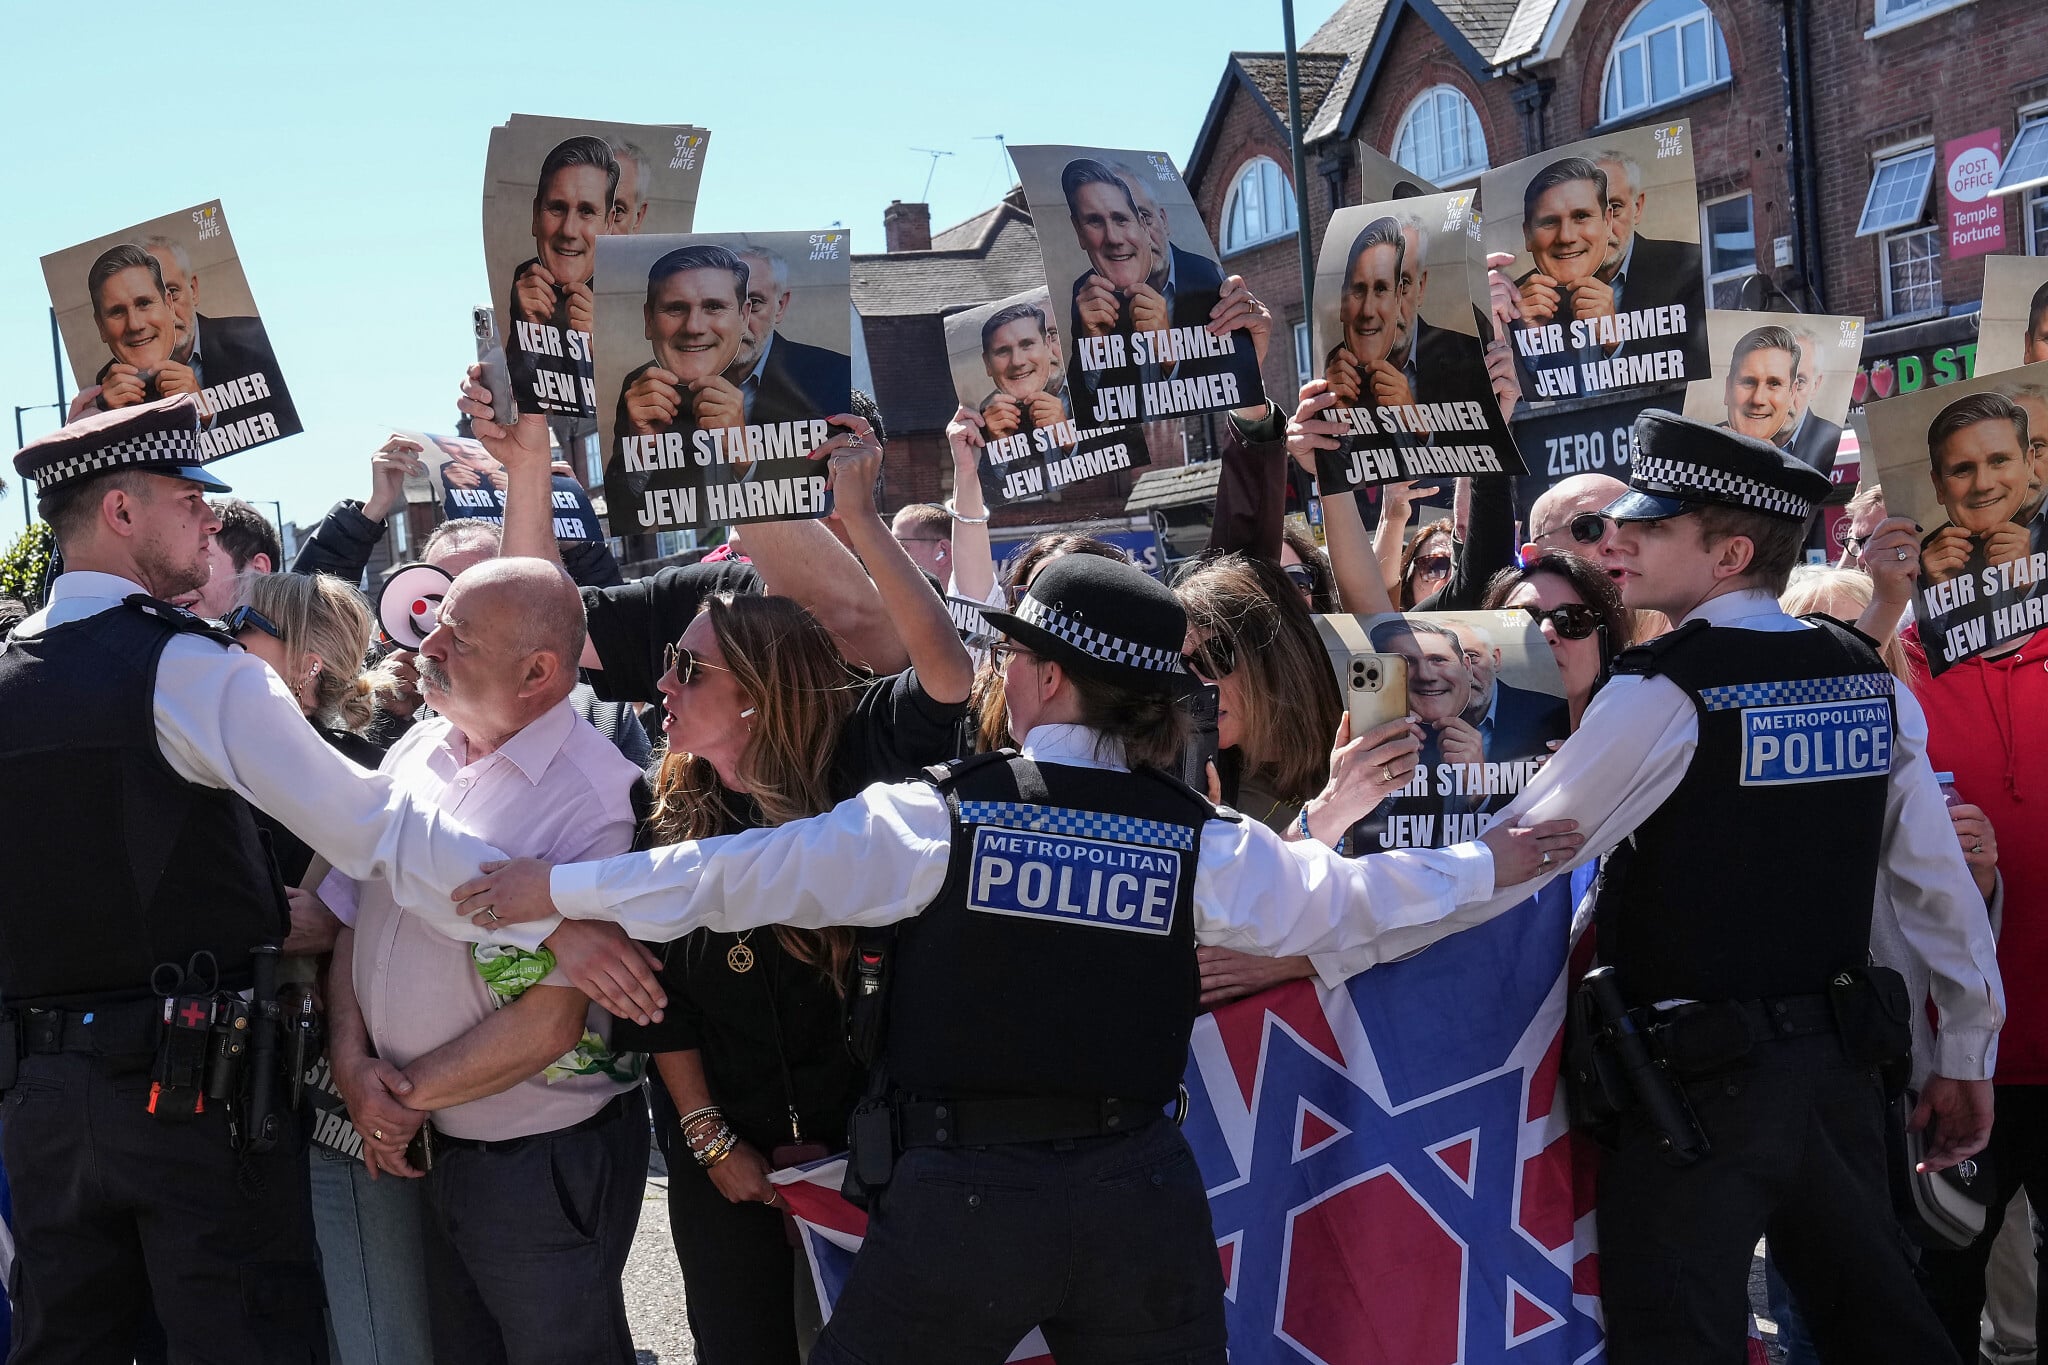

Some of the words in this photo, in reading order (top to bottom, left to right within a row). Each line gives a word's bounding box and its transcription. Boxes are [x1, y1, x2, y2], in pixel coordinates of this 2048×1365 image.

[676, 146, 696, 158] THE
[1656, 145, 1682, 158] HATE
[1659, 136, 1679, 147] THE
[669, 157, 694, 169] HATE
[1153, 164, 1170, 172] THE
[1156, 172, 1176, 181] HATE
[1958, 158, 1988, 177] POST
[1954, 171, 1993, 193] OFFICE
[197, 216, 216, 230] THE
[1442, 219, 1461, 232] HATE
[1448, 208, 1462, 220] THE
[1953, 203, 1998, 227] Temple
[198, 226, 220, 240] HATE
[813, 242, 838, 251] THE
[1952, 224, 2001, 247] Fortune
[809, 250, 839, 260] HATE
[516, 320, 564, 358] KEIR
[566, 329, 594, 363] ST
[1514, 323, 1565, 357] KEIR
[1570, 303, 1687, 349] STARMER
[1838, 339, 1856, 348] HATE
[1841, 330, 1856, 338] THE
[1078, 334, 1127, 372] KEIR
[1130, 325, 1236, 367] STARMER
[533, 368, 577, 404] JEW
[1535, 365, 1577, 397] JEW
[1581, 349, 1685, 392] HARMER
[1092, 384, 1137, 422] JEW
[1142, 372, 1241, 416] HARMER
[1376, 401, 1489, 434] STARMER
[198, 411, 280, 462] ARMER
[622, 432, 686, 473] KEIR
[692, 419, 829, 467] STARMER
[986, 432, 1032, 466] KEIR
[1345, 448, 1399, 485] JEW
[1400, 445, 1503, 476] HARMER
[1545, 431, 1606, 477] ZERO
[1612, 425, 1635, 466] G
[1002, 466, 1044, 499] JEW
[1047, 443, 1131, 487] HARMER
[1829, 467, 1844, 484] ry
[450, 488, 494, 508] KEIR
[637, 487, 697, 527] JEW
[706, 475, 826, 521] HARMER
[1923, 573, 1976, 620] KEIR
[1981, 550, 2048, 597] STAR
[1942, 615, 1987, 662] JEW
[1752, 707, 1887, 731] METROPOLITAN
[1751, 726, 1888, 777] POLICE
[1436, 761, 1541, 797] STARME
[1379, 814, 1435, 849] JEW
[983, 834, 1172, 874] METROPOLITAN
[977, 856, 1171, 925] POLICE
